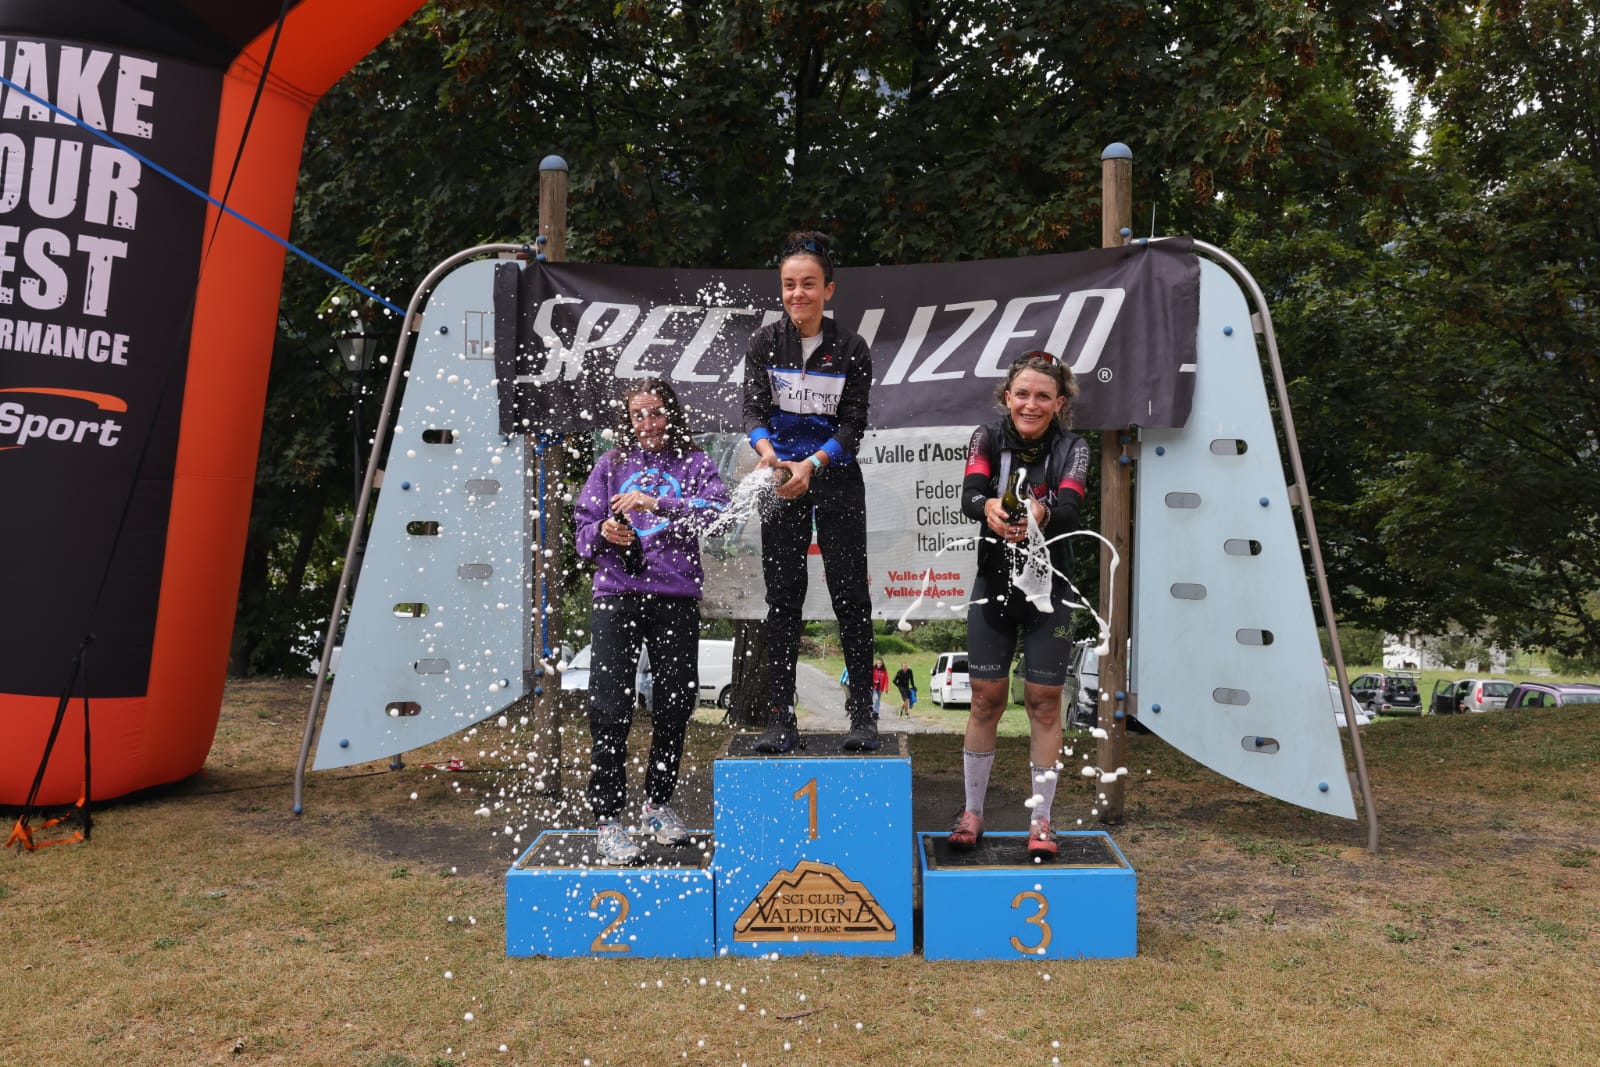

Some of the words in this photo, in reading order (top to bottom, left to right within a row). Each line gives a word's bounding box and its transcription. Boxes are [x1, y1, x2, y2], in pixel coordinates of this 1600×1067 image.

[0, 41, 158, 139] AKE
[515, 287, 1126, 386] SPECIZED
[0, 402, 122, 447] Sport
[875, 445, 915, 464] Valle
[916, 480, 961, 499] Feder
[919, 567, 960, 582] dAosta
[794, 777, 817, 840] 1
[590, 889, 631, 952] 2
[755, 896, 878, 923] VALDIGNE
[782, 894, 804, 904] SCI
[808, 894, 846, 904] CLUB
[1009, 890, 1052, 955] 3
